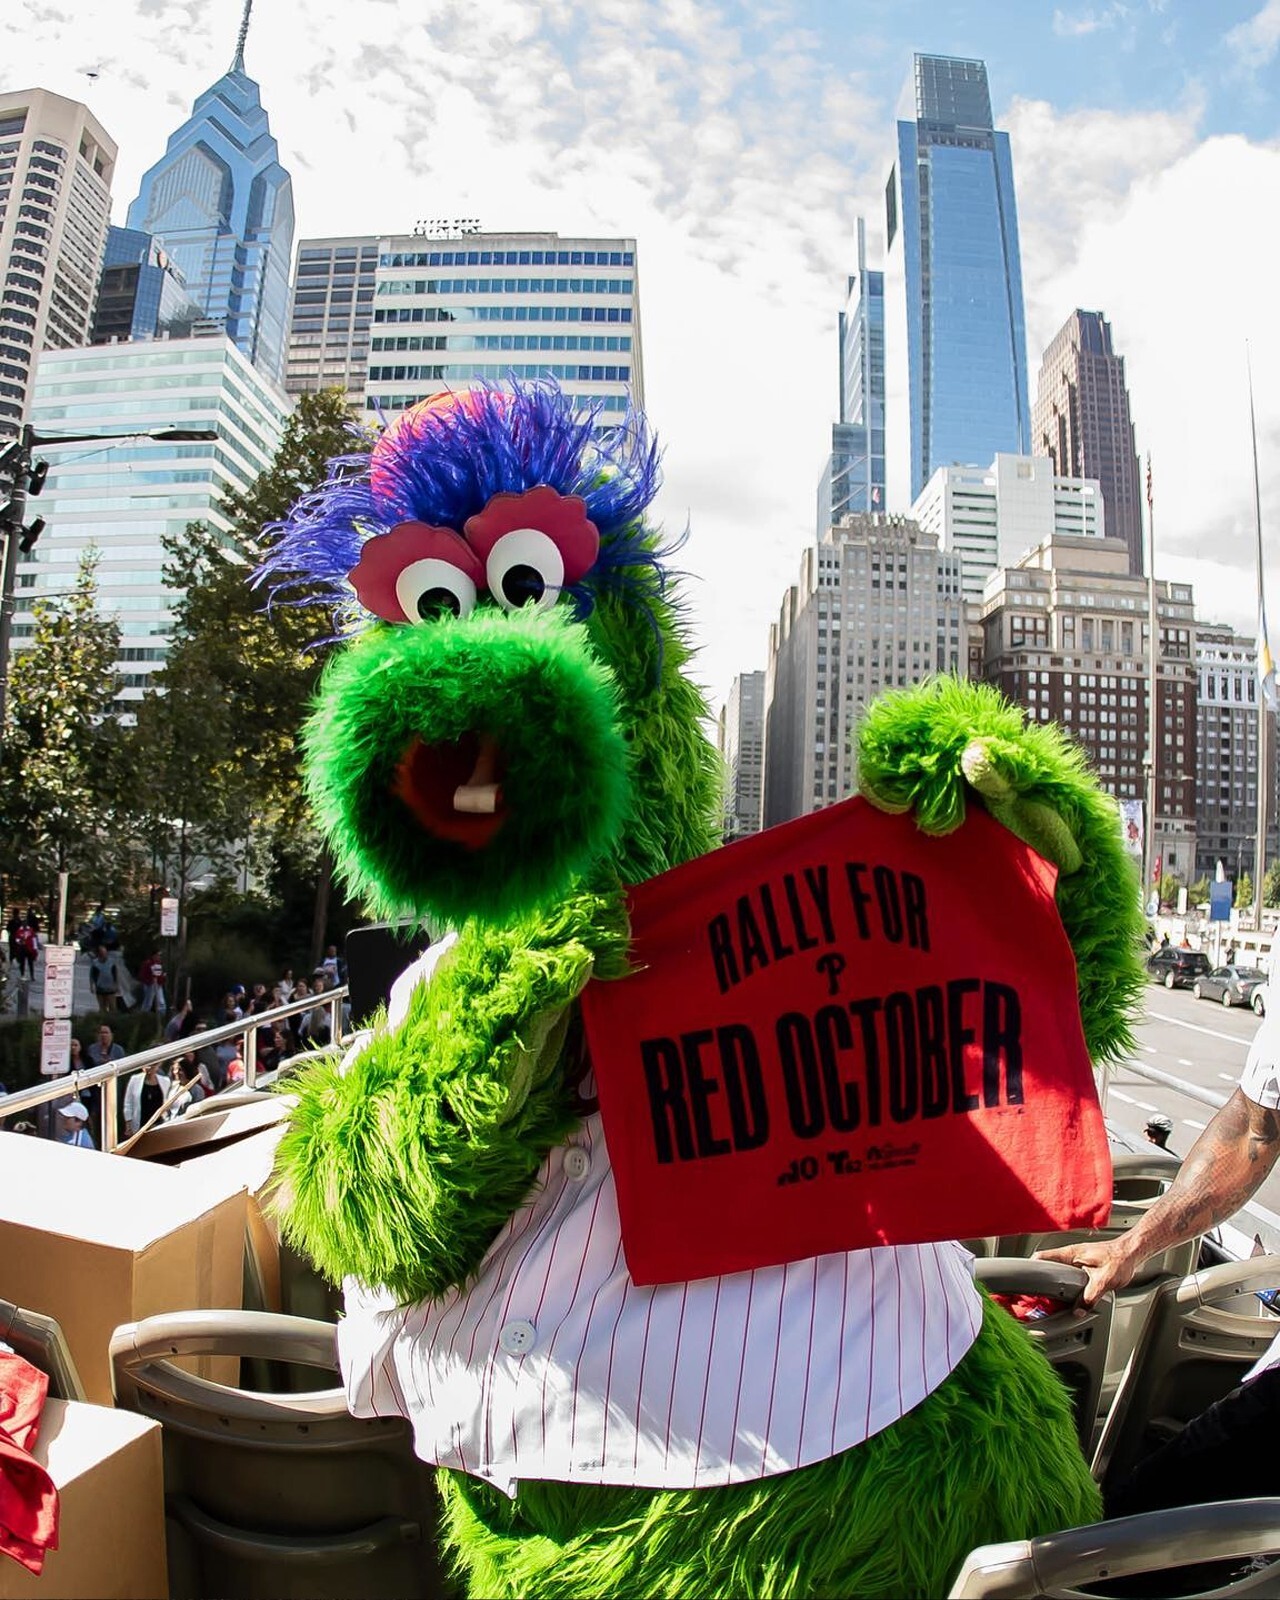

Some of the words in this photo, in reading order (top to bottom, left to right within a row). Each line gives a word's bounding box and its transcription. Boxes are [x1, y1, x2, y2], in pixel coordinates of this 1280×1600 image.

[707, 864, 836, 995] RALLY
[845, 862, 931, 953] FOR
[640, 1023, 770, 1165] RED
[775, 978, 1024, 1140] OCTOBER
